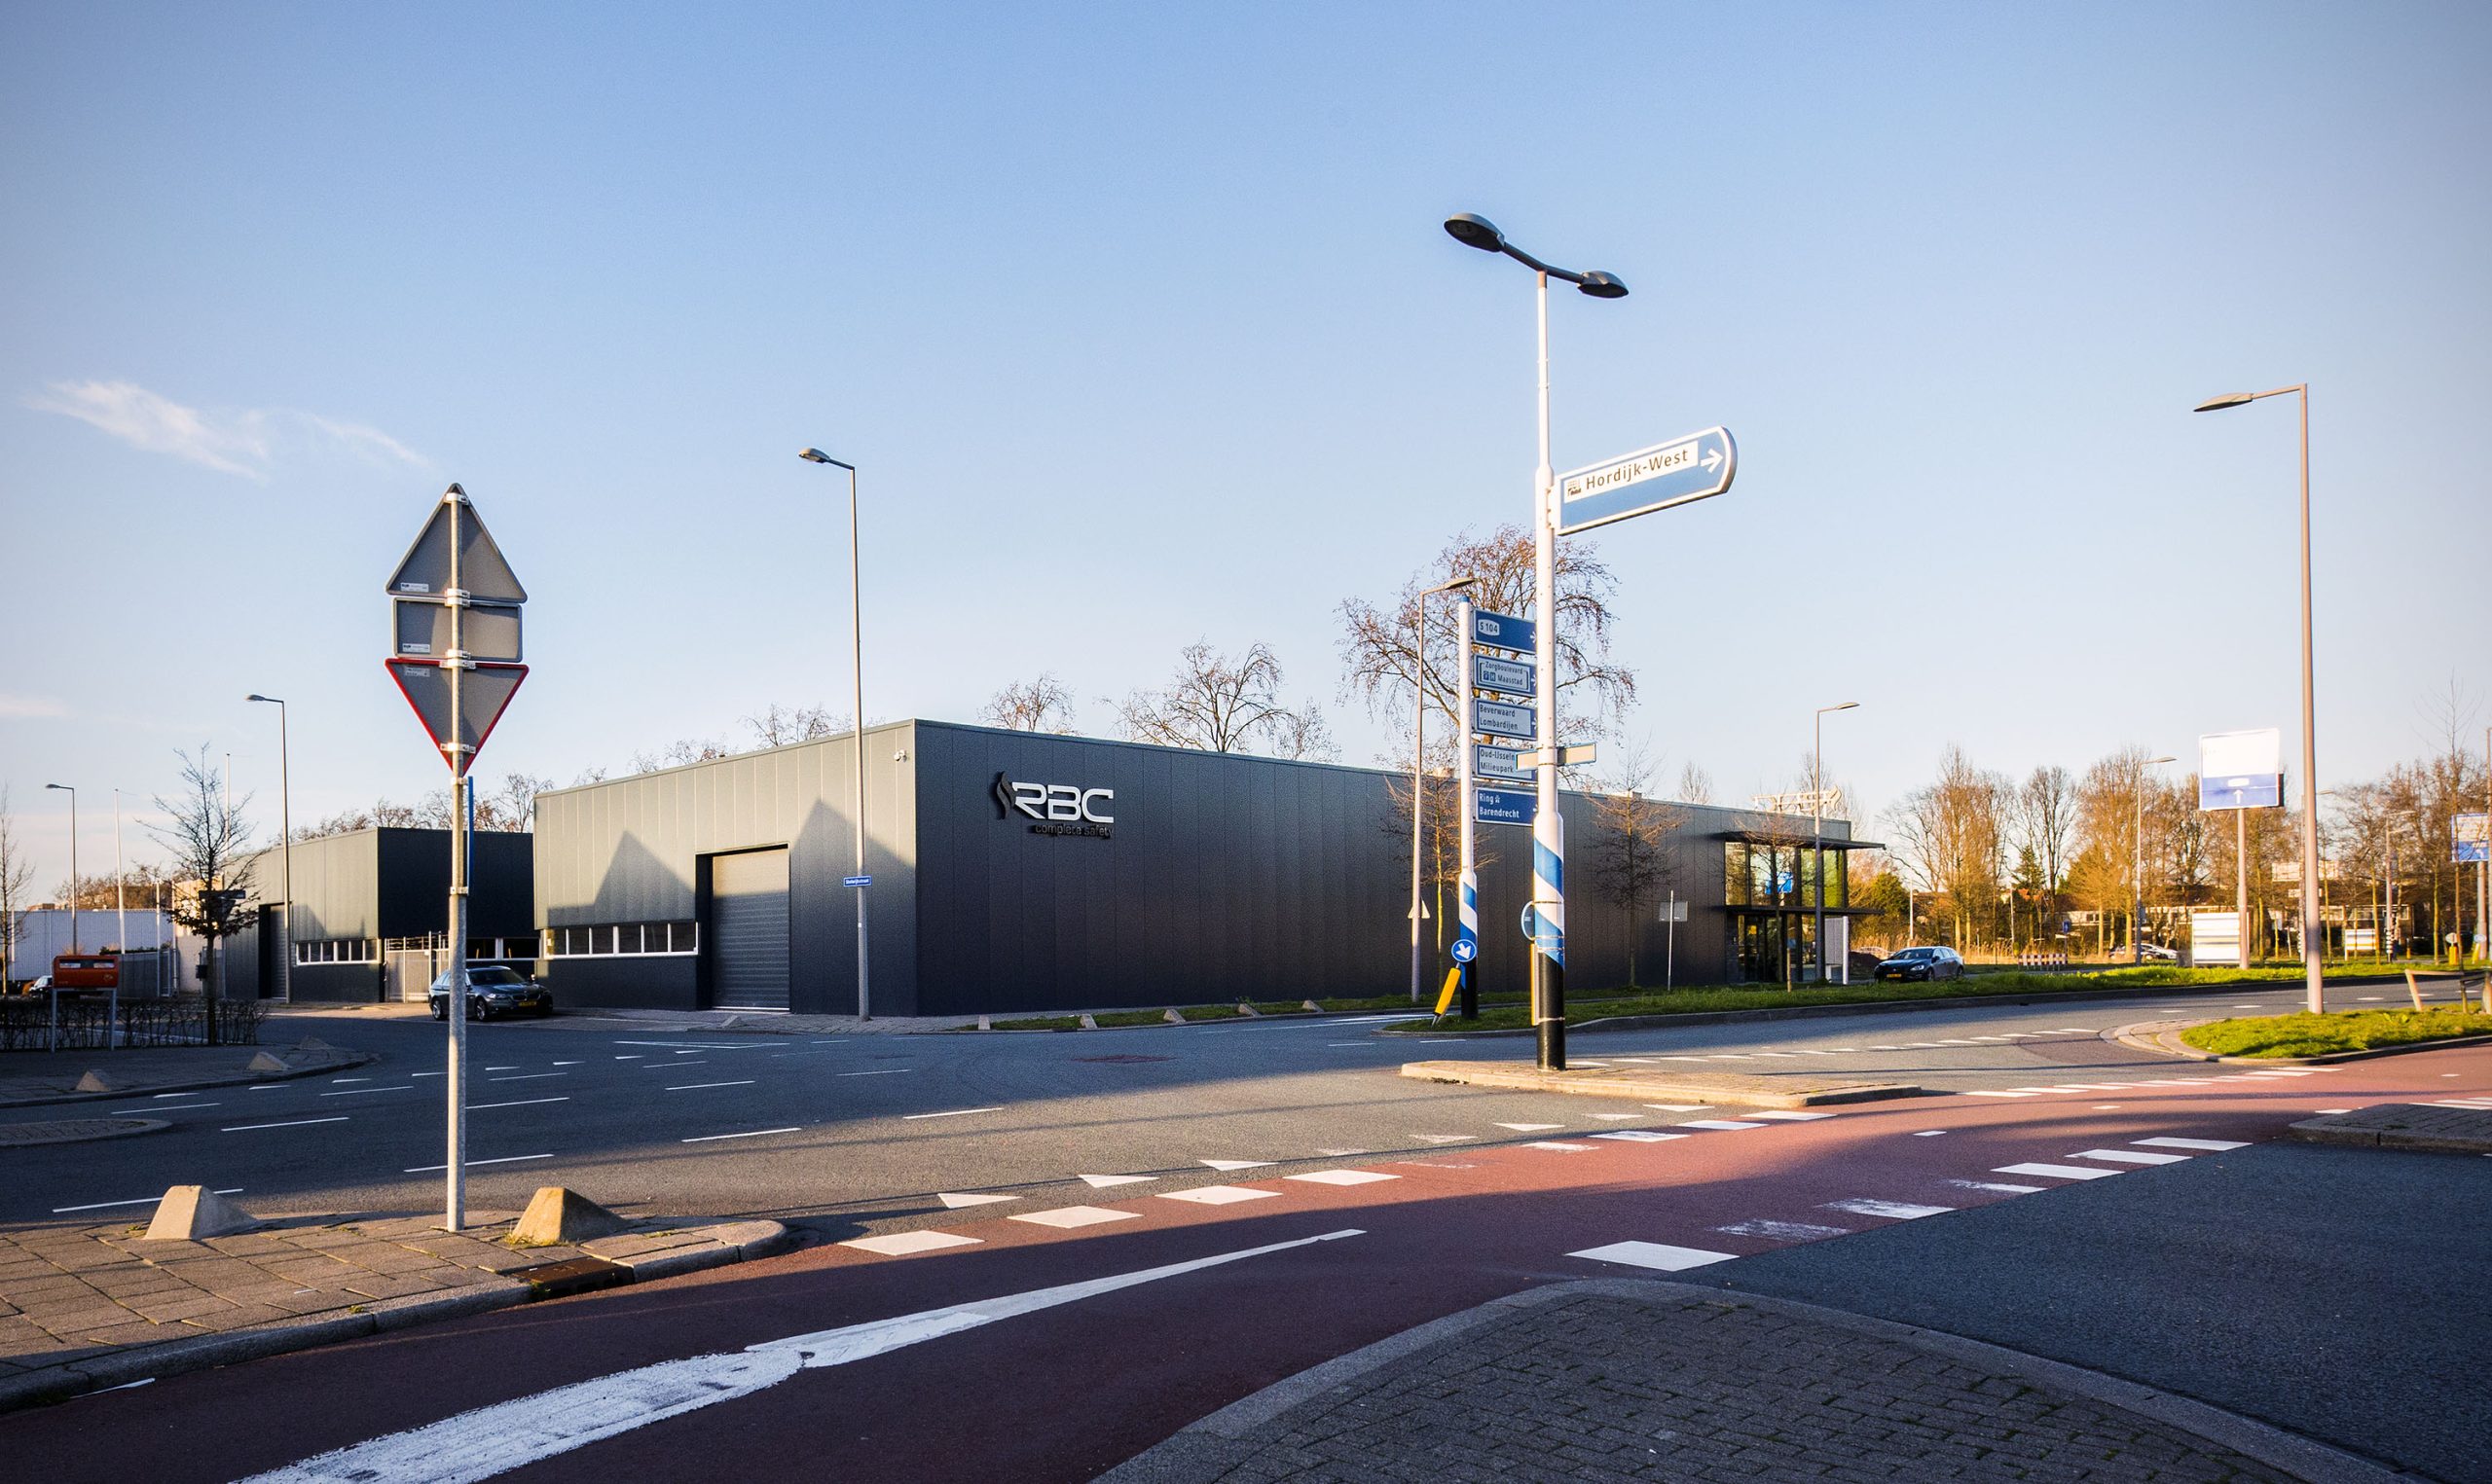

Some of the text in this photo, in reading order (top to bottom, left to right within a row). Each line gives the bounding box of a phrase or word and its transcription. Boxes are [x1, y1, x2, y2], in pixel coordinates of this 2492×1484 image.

[1586, 449, 1689, 489] Hordijk-West
[1480, 704, 1516, 717] Beverwaard
[1480, 717, 1519, 731] Lombardijen
[1480, 762, 1514, 775] Milieupark
[1011, 781, 1115, 823] RBC
[1479, 793, 1494, 805] Ring
[1479, 806, 1520, 818] Barendrecht
[1035, 824, 1115, 839] complete safety
